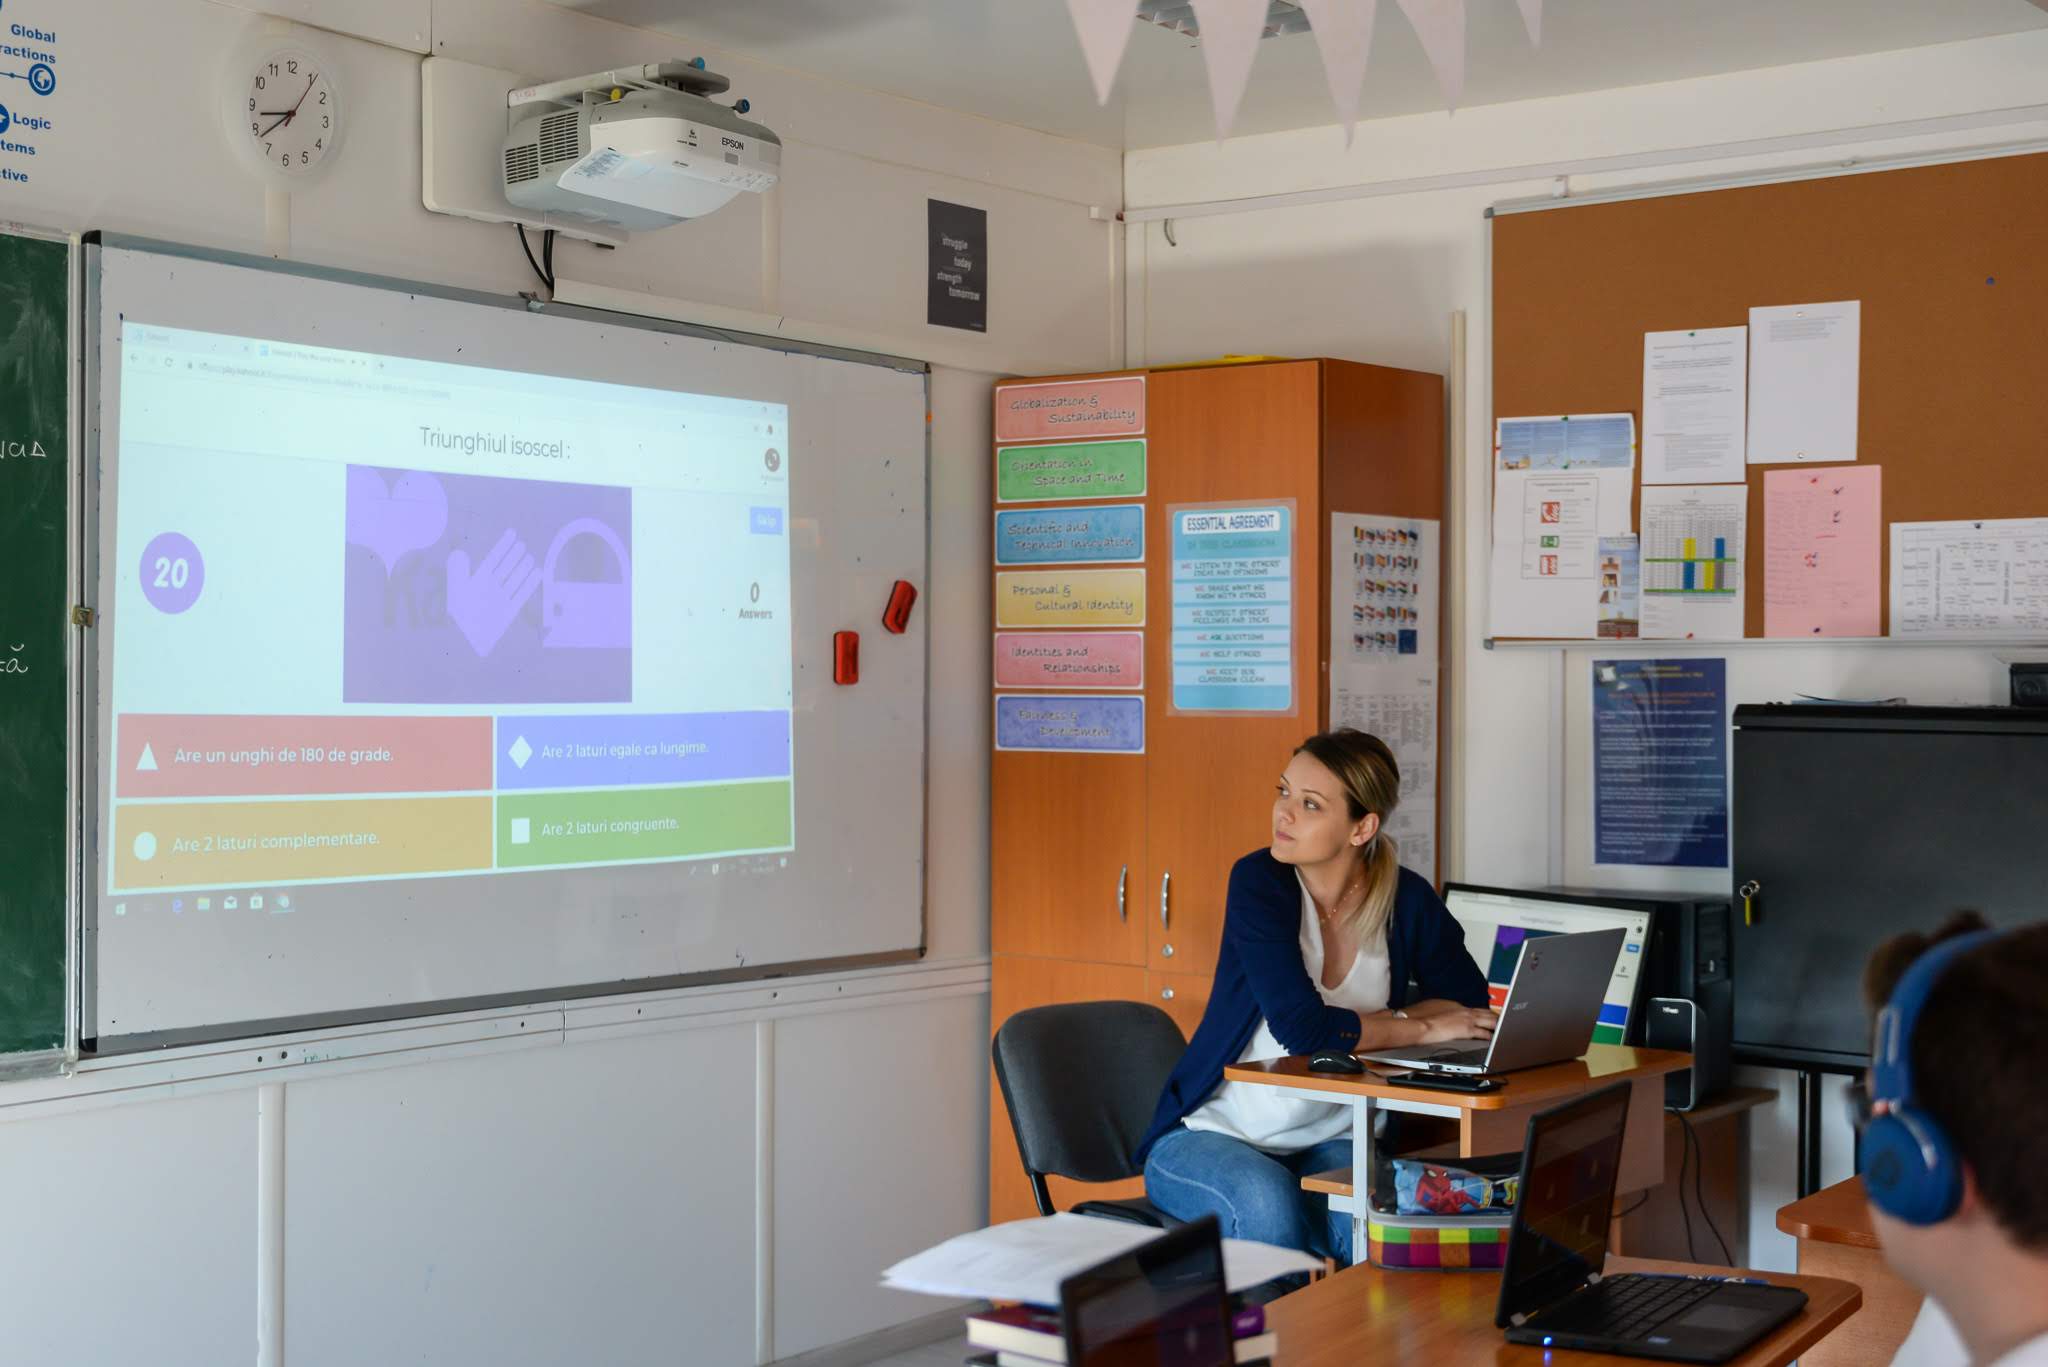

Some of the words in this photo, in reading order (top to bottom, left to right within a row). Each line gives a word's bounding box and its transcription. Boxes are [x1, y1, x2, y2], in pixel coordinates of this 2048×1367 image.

[11, 24, 56, 43] Global
[269, 63, 279, 77] 11
[287, 60, 298, 74] 12
[255, 76, 266, 90] 10
[249, 98, 256, 111] 9
[319, 92, 326, 105] 2
[13, 112, 52, 130] Logic
[322, 116, 329, 129] 3
[252, 123, 260, 136] 8
[265, 142, 273, 156] 7
[315, 138, 322, 151] 4
[721, 137, 744, 152] EPSON
[282, 153, 290, 167] 6
[302, 151, 309, 164] 5
[0, 168, 28, 183] tive
[942, 237, 968, 251] struggle
[953, 256, 972, 271] today
[937, 272, 963, 285] strength
[948, 286, 980, 301] tomorrow
[1010, 398, 1086, 411] Globalization
[1089, 394, 1099, 409] &
[1047, 409, 1137, 425] Sustainability
[419, 425, 508, 455] Triunghiul
[1011, 460, 1076, 473] Orientation
[1033, 474, 1068, 488] Space
[1069, 473, 1093, 484] and
[1096, 471, 1126, 484] Time
[1007, 523, 1063, 537] Scientific
[1066, 520, 1089, 533] and
[1187, 516, 1227, 531] ESSENTIAL
[1229, 514, 1275, 529] AGREEMENT
[1015, 538, 1067, 551] Technical
[153, 556, 189, 590] 20
[750, 582, 760, 604] 0
[1012, 583, 1060, 597] Personal
[1062, 584, 1071, 599] &
[738, 608, 774, 621] Answers
[1035, 600, 1084, 612] Cultural
[1086, 599, 1134, 617] Identity
[1011, 647, 1062, 658] Identities
[1066, 646, 1089, 657] and
[1043, 662, 1121, 675] Relationships
[1018, 708, 1068, 720] Fairness
[1039, 726, 1112, 738] Development
[174, 747, 202, 764] Are
[206, 750, 226, 764] un
[230, 746, 275, 767] unghi
[278, 747, 297, 763] de
[300, 747, 325, 763] 180
[328, 746, 347, 762] de
[350, 746, 395, 766] grade.
[542, 743, 564, 760] Are
[566, 744, 575, 760] 2
[576, 742, 608, 759] laturi
[610, 742, 642, 762] egale
[644, 743, 658, 757] ca
[660, 740, 710, 759] lungime.
[542, 821, 564, 838] Are
[566, 821, 575, 837] 2
[576, 818, 608, 835] laturi
[610, 816, 680, 835] congruente.
[172, 836, 199, 854] Are
[204, 836, 214, 852] 2
[217, 833, 258, 852] laturi
[260, 830, 381, 851] complementare.
